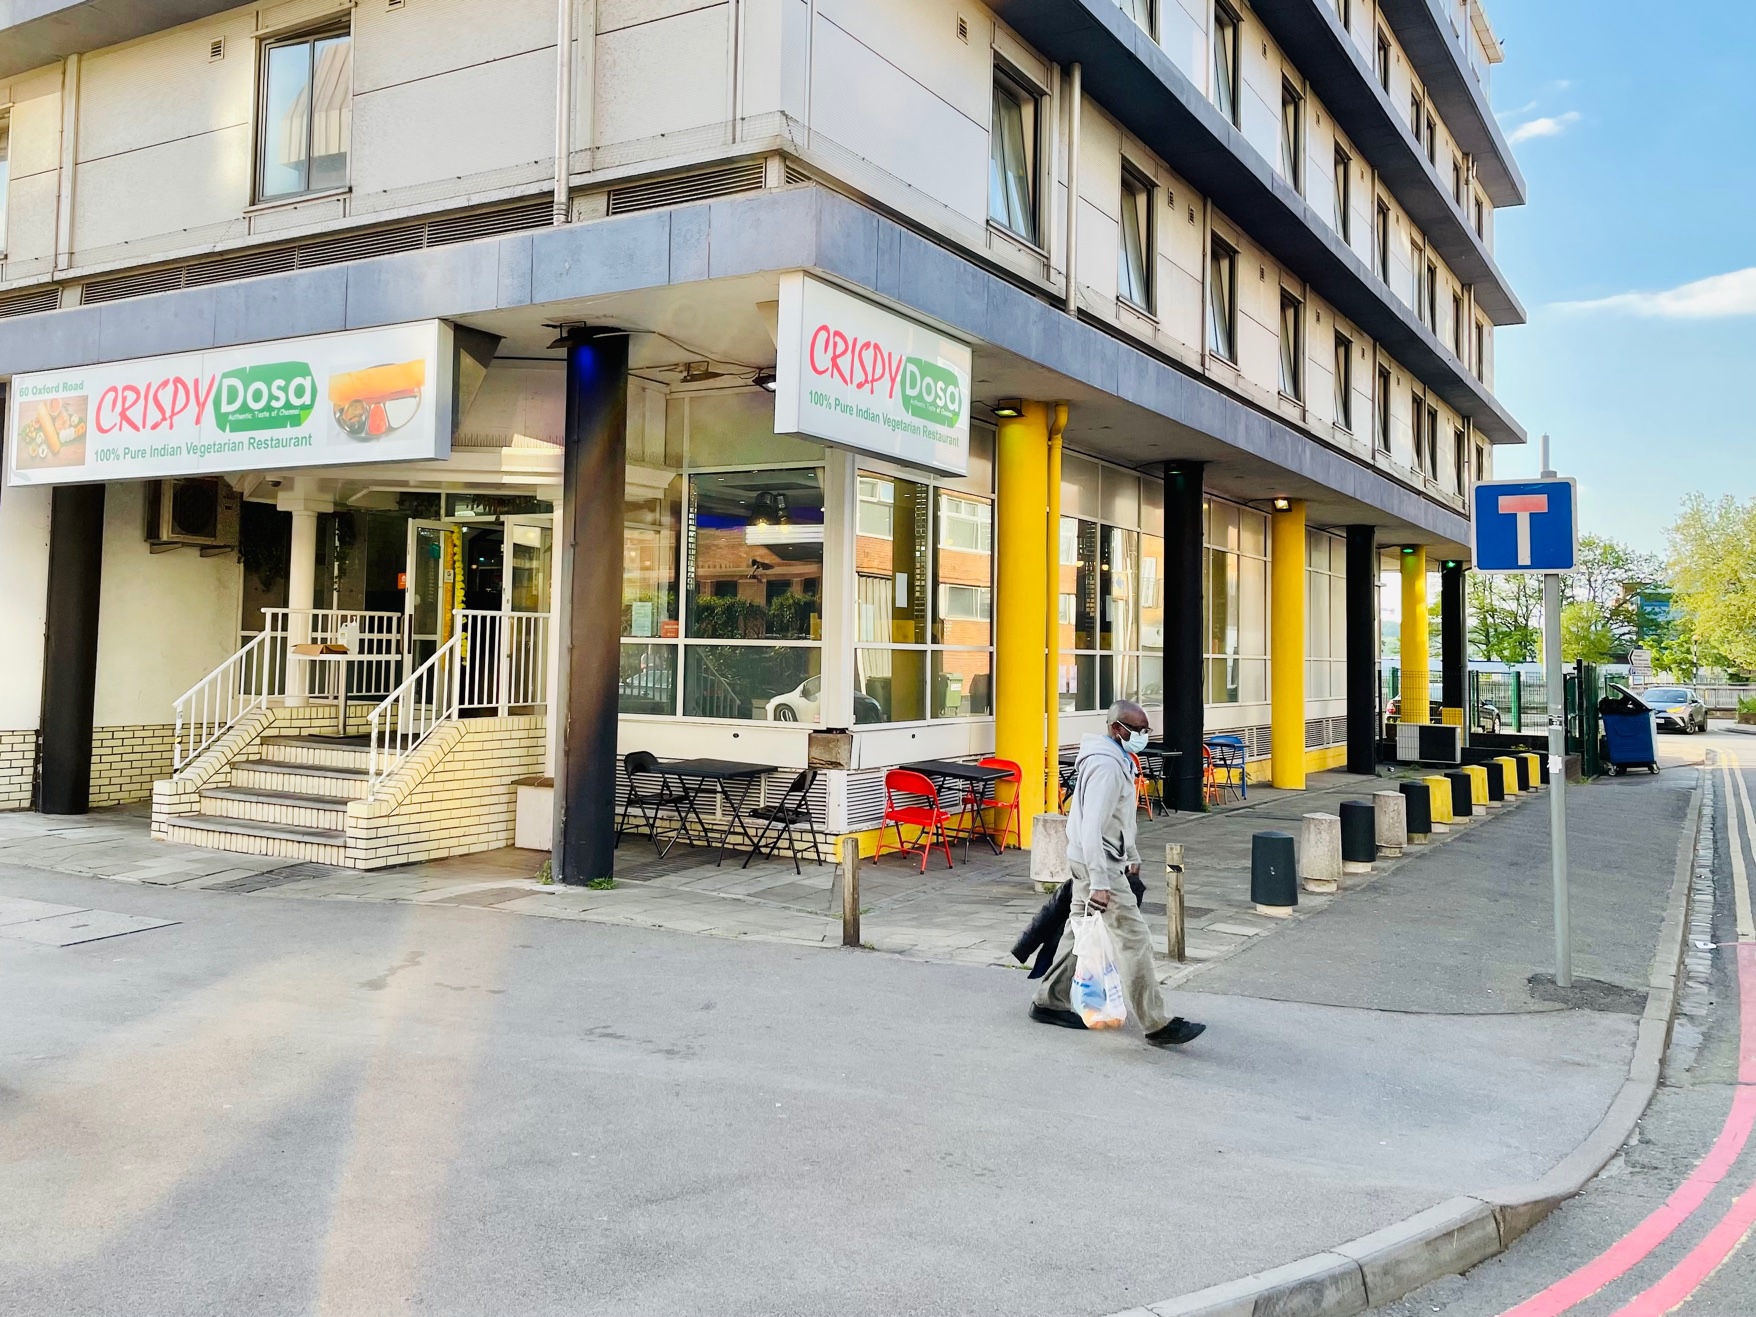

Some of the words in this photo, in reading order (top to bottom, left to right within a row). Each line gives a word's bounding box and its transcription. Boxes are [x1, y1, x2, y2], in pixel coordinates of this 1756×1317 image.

[19, 387, 29, 397] 60
[32, 383, 60, 396] Oxford
[62, 380, 84, 392] Road
[809, 324, 903, 399] CRISPY
[905, 362, 959, 413] Dosa
[95, 373, 216, 434] CRISPY
[221, 375, 312, 413] Dosa
[809, 390, 832, 410] 100%
[834, 397, 854, 416] Pure
[856, 404, 880, 424] Indian
[882, 412, 921, 436] Vegetarian
[922, 425, 960, 447] Restaurant
[94, 447, 120, 462] 100%
[123, 446, 147, 460] Pure
[150, 443, 182, 458] Indian
[185, 438, 244, 458] Vegetarian
[248, 433, 312, 451] Restaurant
